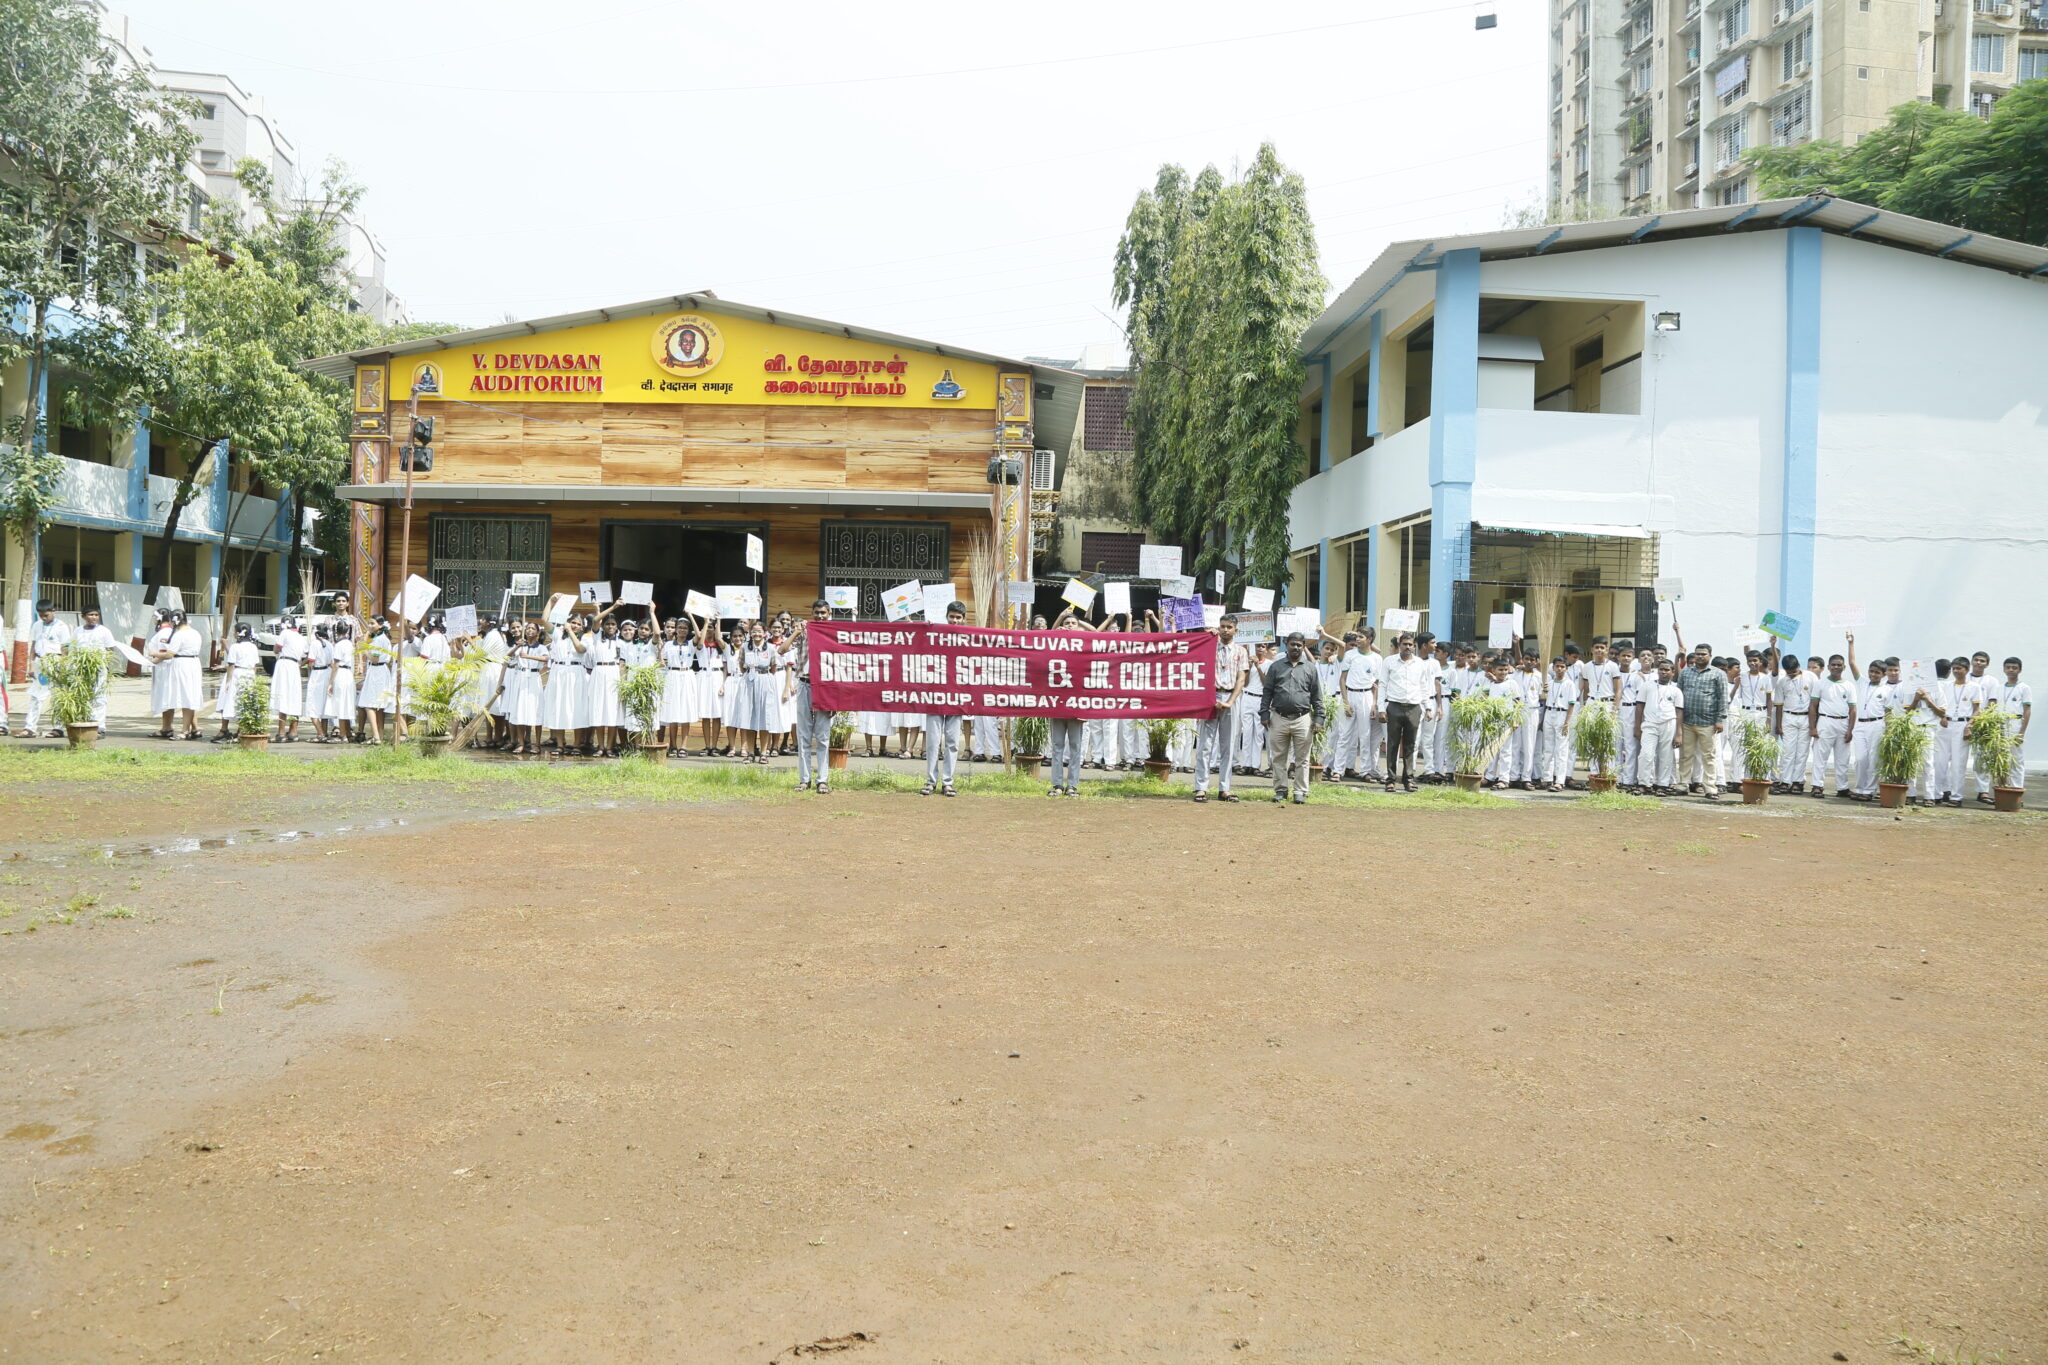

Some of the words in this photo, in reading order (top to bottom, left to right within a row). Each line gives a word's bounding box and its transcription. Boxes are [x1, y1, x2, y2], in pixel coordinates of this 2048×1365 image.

[472, 354, 488, 370] V.
[494, 354, 602, 371] DEVDASAN
[764, 353, 793, 373] வி.
[797, 353, 908, 377] தேவதாசன்
[470, 374, 604, 393] AUDITORIUM
[764, 374, 907, 399] கலையரங்கம்
[836, 630, 917, 647] BOMBAY
[926, 631, 1084, 653] THIRUVALLUVAR
[1091, 639, 1189, 655] MANRAM'S
[820, 651, 893, 683] BRIGHT
[901, 654, 948, 685] HIGH
[955, 655, 1032, 688] SCHOOL
[1048, 658, 1074, 689] &
[1083, 660, 1114, 690] JR.
[1119, 661, 1206, 691] COLLEGE
